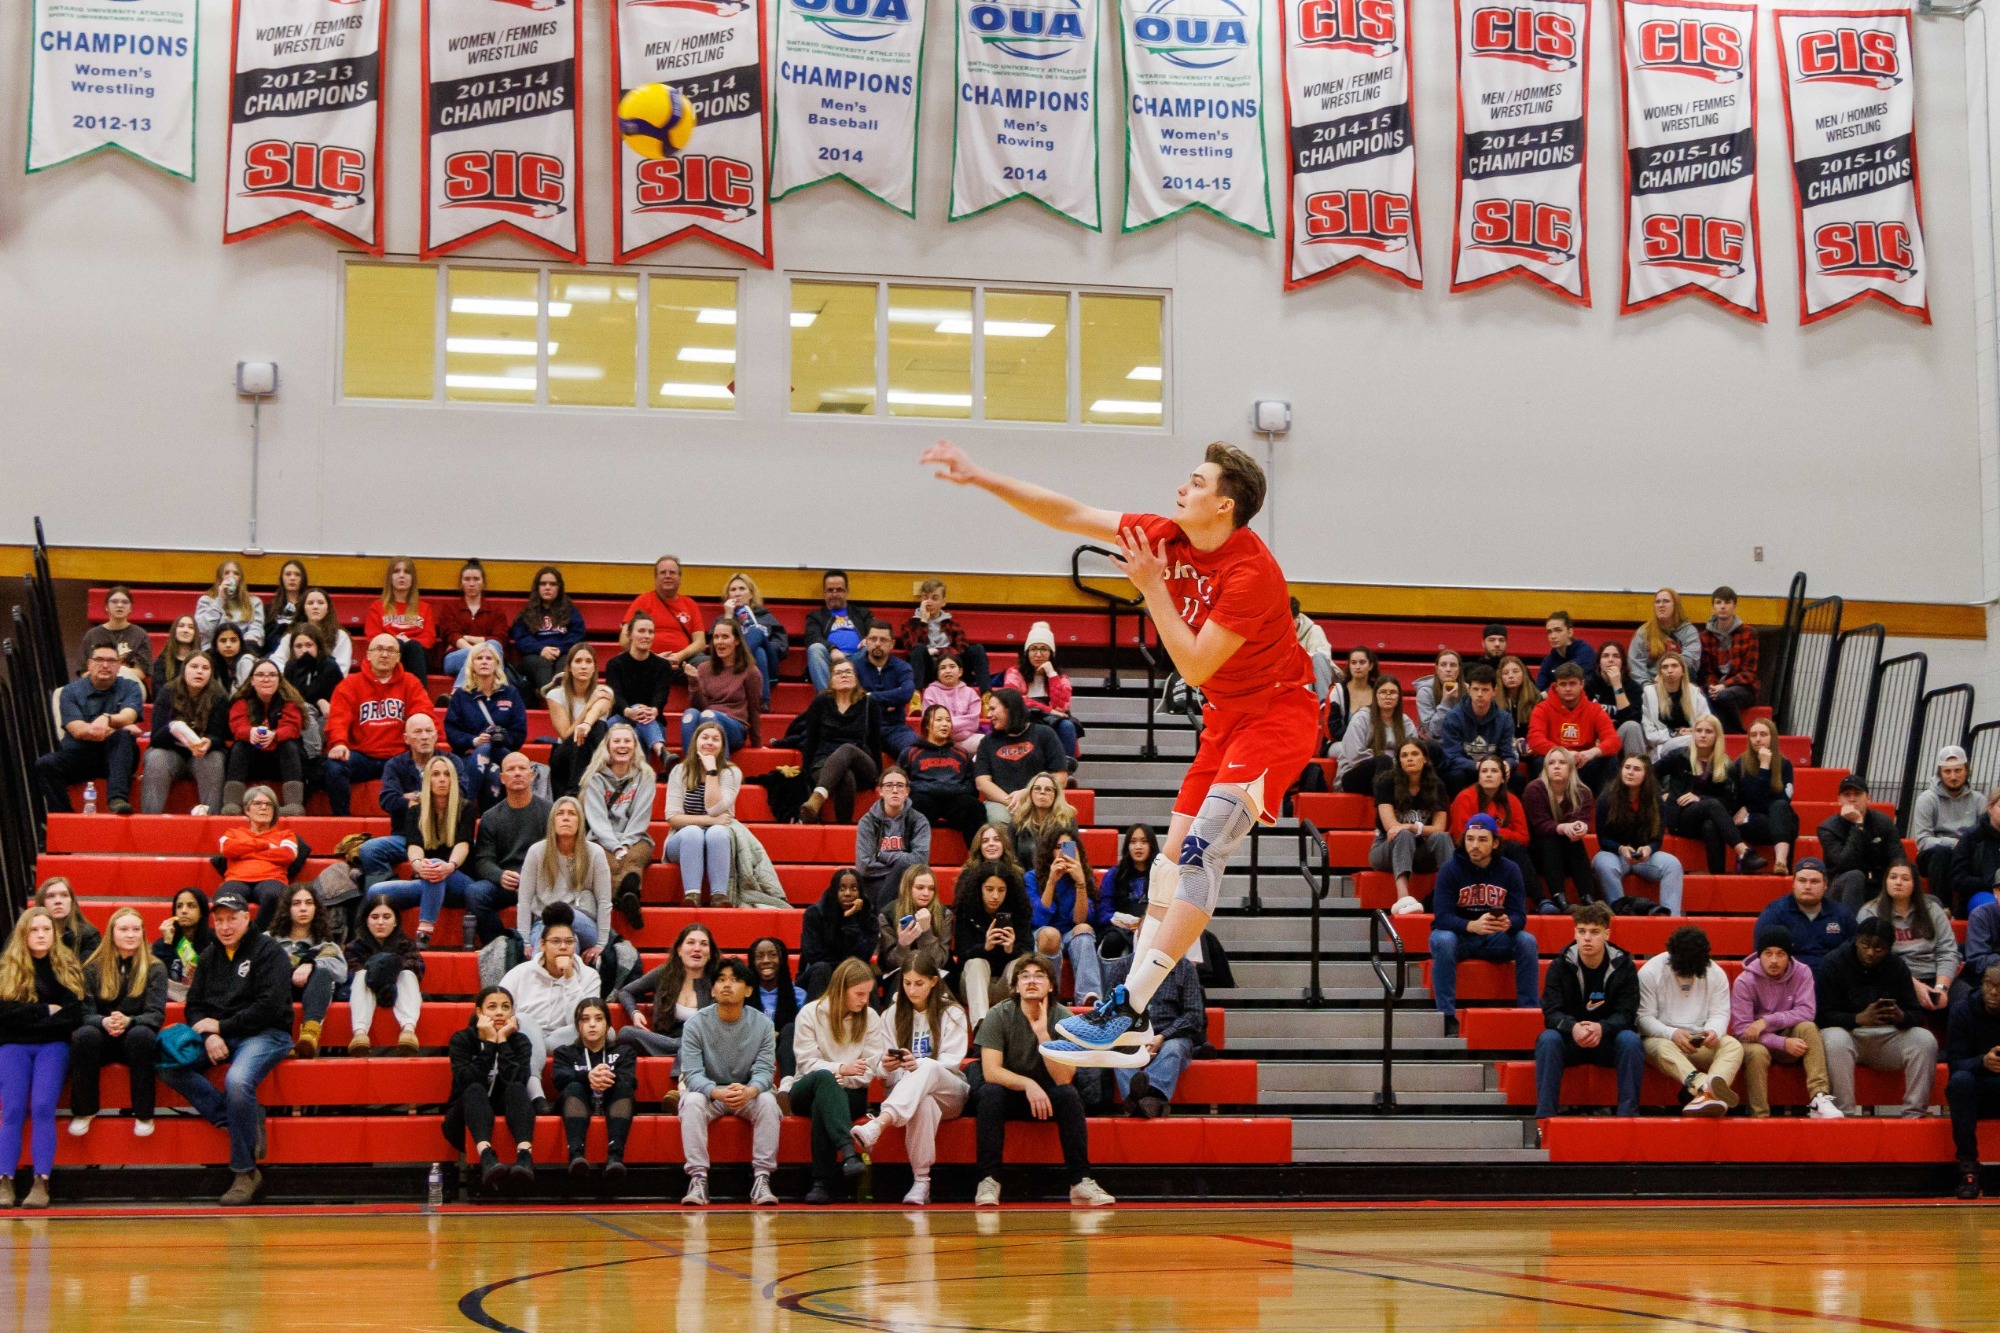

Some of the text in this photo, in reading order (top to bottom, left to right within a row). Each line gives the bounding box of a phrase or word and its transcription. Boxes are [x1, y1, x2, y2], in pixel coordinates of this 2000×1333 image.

[256, 25, 302, 42] WOMEN
[313, 15, 362, 35] FEMMES
[969, 4, 1085, 39] OUA
[1133, 15, 1249, 46] OUA
[1298, 0, 1396, 42] CIS
[1472, 6, 1576, 60] CIS
[40, 30, 188, 57] CHAMPIONS
[273, 35, 345, 57] WRESTLING
[448, 31, 495, 52] WOMEN
[506, 21, 558, 41] FEMMES
[645, 40, 673, 57] MEN
[682, 28, 735, 49] HOMMES
[1638, 19, 1743, 70] CIS
[467, 40, 539, 65] WRESTLING
[656, 46, 725, 71] WRESTLING
[1797, 28, 1900, 77] CIS
[75, 63, 152, 78] Women's
[262, 65, 353, 89] 2012-13
[781, 61, 913, 96] CHAMPIONS
[71, 80, 155, 98] Wrestling
[245, 81, 368, 116] CHAMPIONS
[457, 71, 549, 99] 2013-14
[678, 75, 736, 99] 13-14
[962, 82, 1089, 112] CHAMPIONS
[1303, 80, 1343, 99] WOMEN
[1320, 86, 1381, 111] WRESTLING
[1481, 90, 1505, 105] MEN
[1514, 83, 1563, 101] HOMMES
[440, 86, 564, 126] CHAMPIONS
[694, 92, 750, 117] PIONS
[821, 97, 867, 113] Men's
[1132, 94, 1257, 119] CHAMPIONS
[1490, 100, 1554, 121] WRESTLING
[1643, 104, 1684, 121] WOMEN
[1692, 94, 1736, 112] FEMMES
[1815, 115, 1839, 131] MEN
[1847, 102, 1888, 123] HOMMES
[72, 115, 151, 131] 2012-13
[808, 113, 878, 131] Baseball
[1003, 118, 1048, 134] Men's
[1160, 128, 1229, 142] Women's
[1312, 113, 1392, 143] 2014-15
[1661, 113, 1719, 133] WRESTLING
[1825, 120, 1882, 143] WRESTLING
[997, 133, 1054, 151] Rowing
[1159, 143, 1233, 158] Wrestling
[1299, 130, 1404, 168] CHAMPIONS
[1481, 127, 1564, 151] 2014-15
[244, 140, 365, 195] SIC
[818, 147, 863, 163] 2014
[1469, 144, 1575, 175] CHAMPIONS
[1648, 141, 1731, 167] 2015-16
[1819, 147, 1897, 176] 2015-16
[444, 150, 563, 202] SIC
[637, 154, 753, 206] SIC
[1003, 166, 1047, 182] 2014
[1162, 175, 1232, 191] 2014-15
[1639, 156, 1743, 189] CHAMPIONS
[1808, 157, 1911, 201] CHAMPIONS
[1306, 189, 1409, 238] SIC
[1472, 198, 1573, 253] SIC
[1643, 213, 1745, 265] SIC
[1815, 220, 1913, 270] SIC
[360, 698, 406, 725] BROCK
[1457, 883, 1508, 908] BROCK
